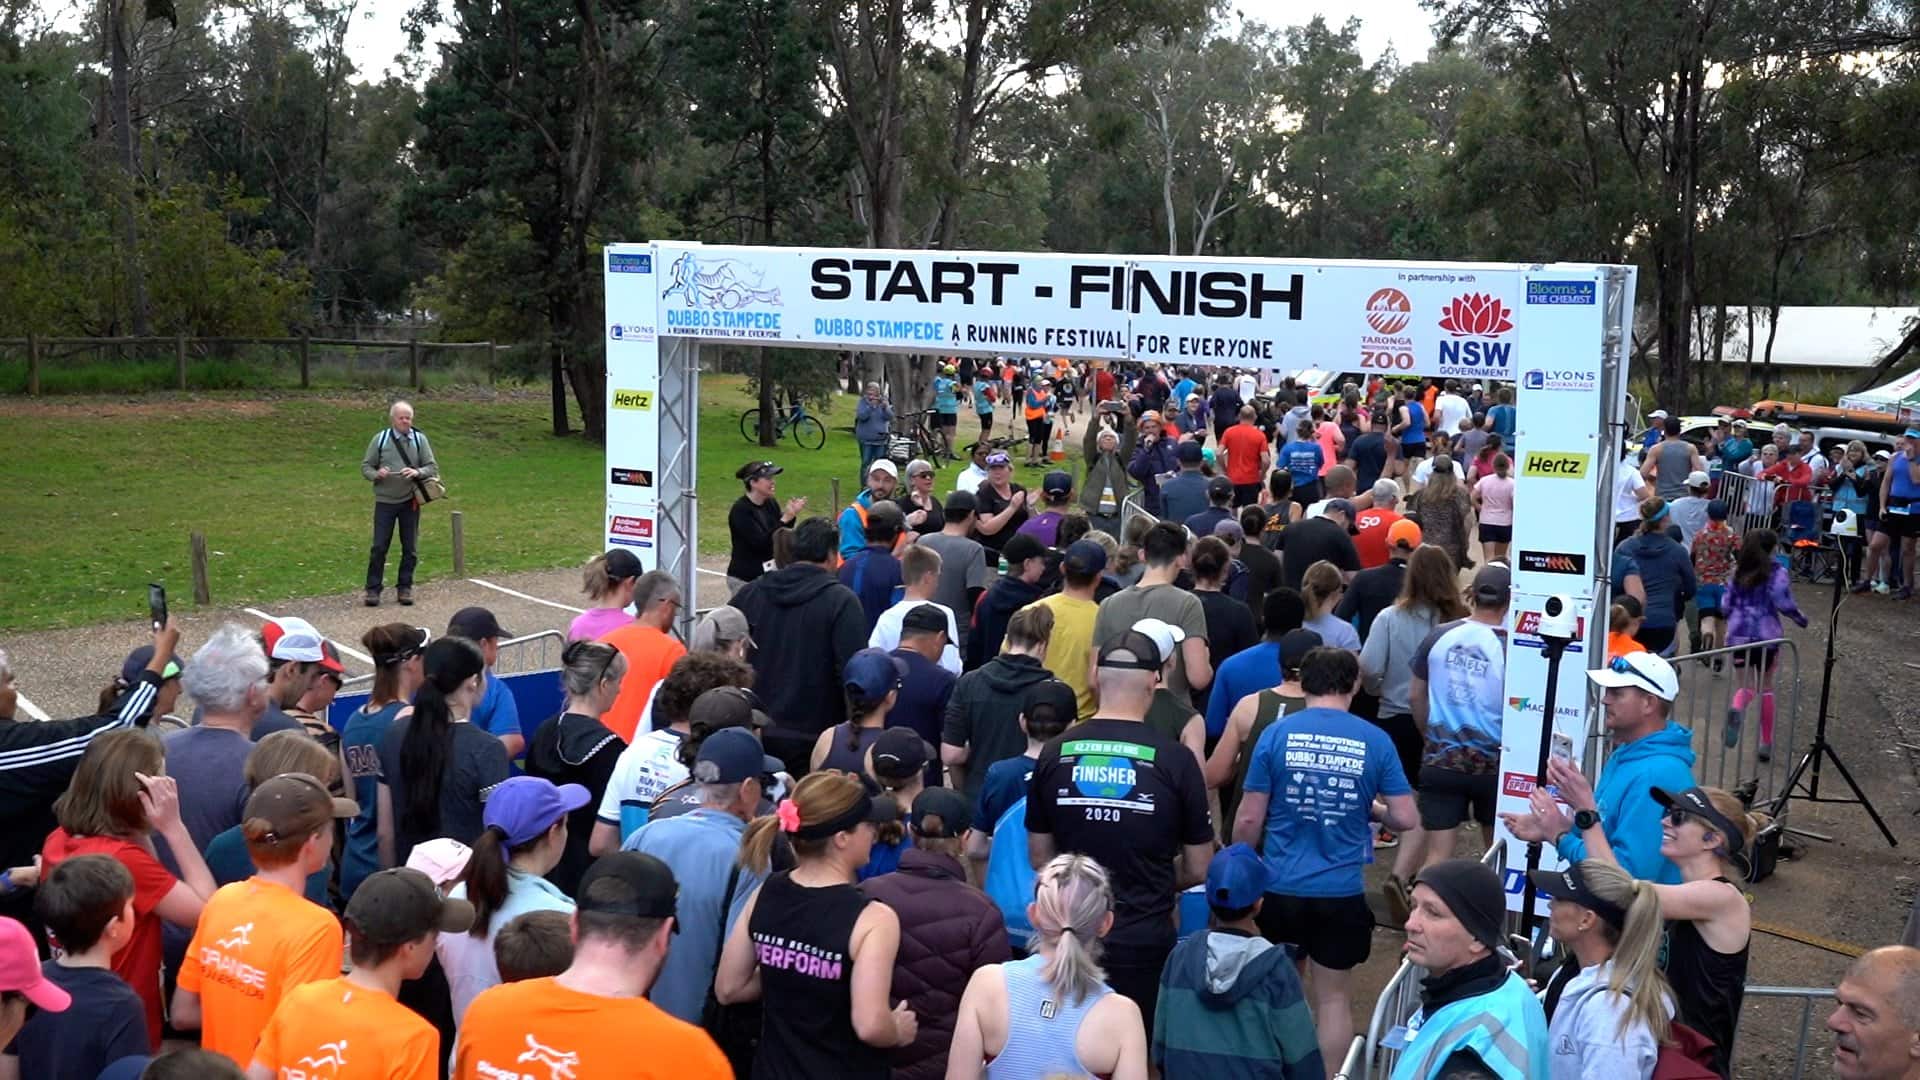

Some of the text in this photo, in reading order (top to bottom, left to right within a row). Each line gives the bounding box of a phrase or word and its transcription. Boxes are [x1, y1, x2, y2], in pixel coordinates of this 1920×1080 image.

[1407, 273, 1456, 284] partnership
[1458, 274, 1477, 283] with
[811, 258, 1019, 305] START
[1070, 265, 1304, 320] FINISH
[1529, 282, 1576, 295] Blooms
[1528, 295, 1592, 304] THE CHEMIST
[667, 309, 782, 330] DUBBO STAMPEDE
[624, 326, 655, 334] LYONS
[815, 318, 1273, 360] DUBBO STAMPEDE A RUNNING FESTIVAL FOR EVERYONE
[1361, 336, 1412, 345] TARONGA
[1360, 351, 1414, 370] ZOO
[1439, 340, 1512, 367] NSW
[1440, 366, 1510, 377] GOVERNMENT
[1545, 371, 1595, 381] LYONS
[615, 393, 648, 408] Hertz
[1286, 751, 1365, 770] DUBBO STAMPEDE
[1072, 766, 1136, 785] FINISHER
[1085, 807, 1121, 822] 2020
[789, 940, 842, 960] RECOVER
[200, 946, 268, 989] ORANGE
